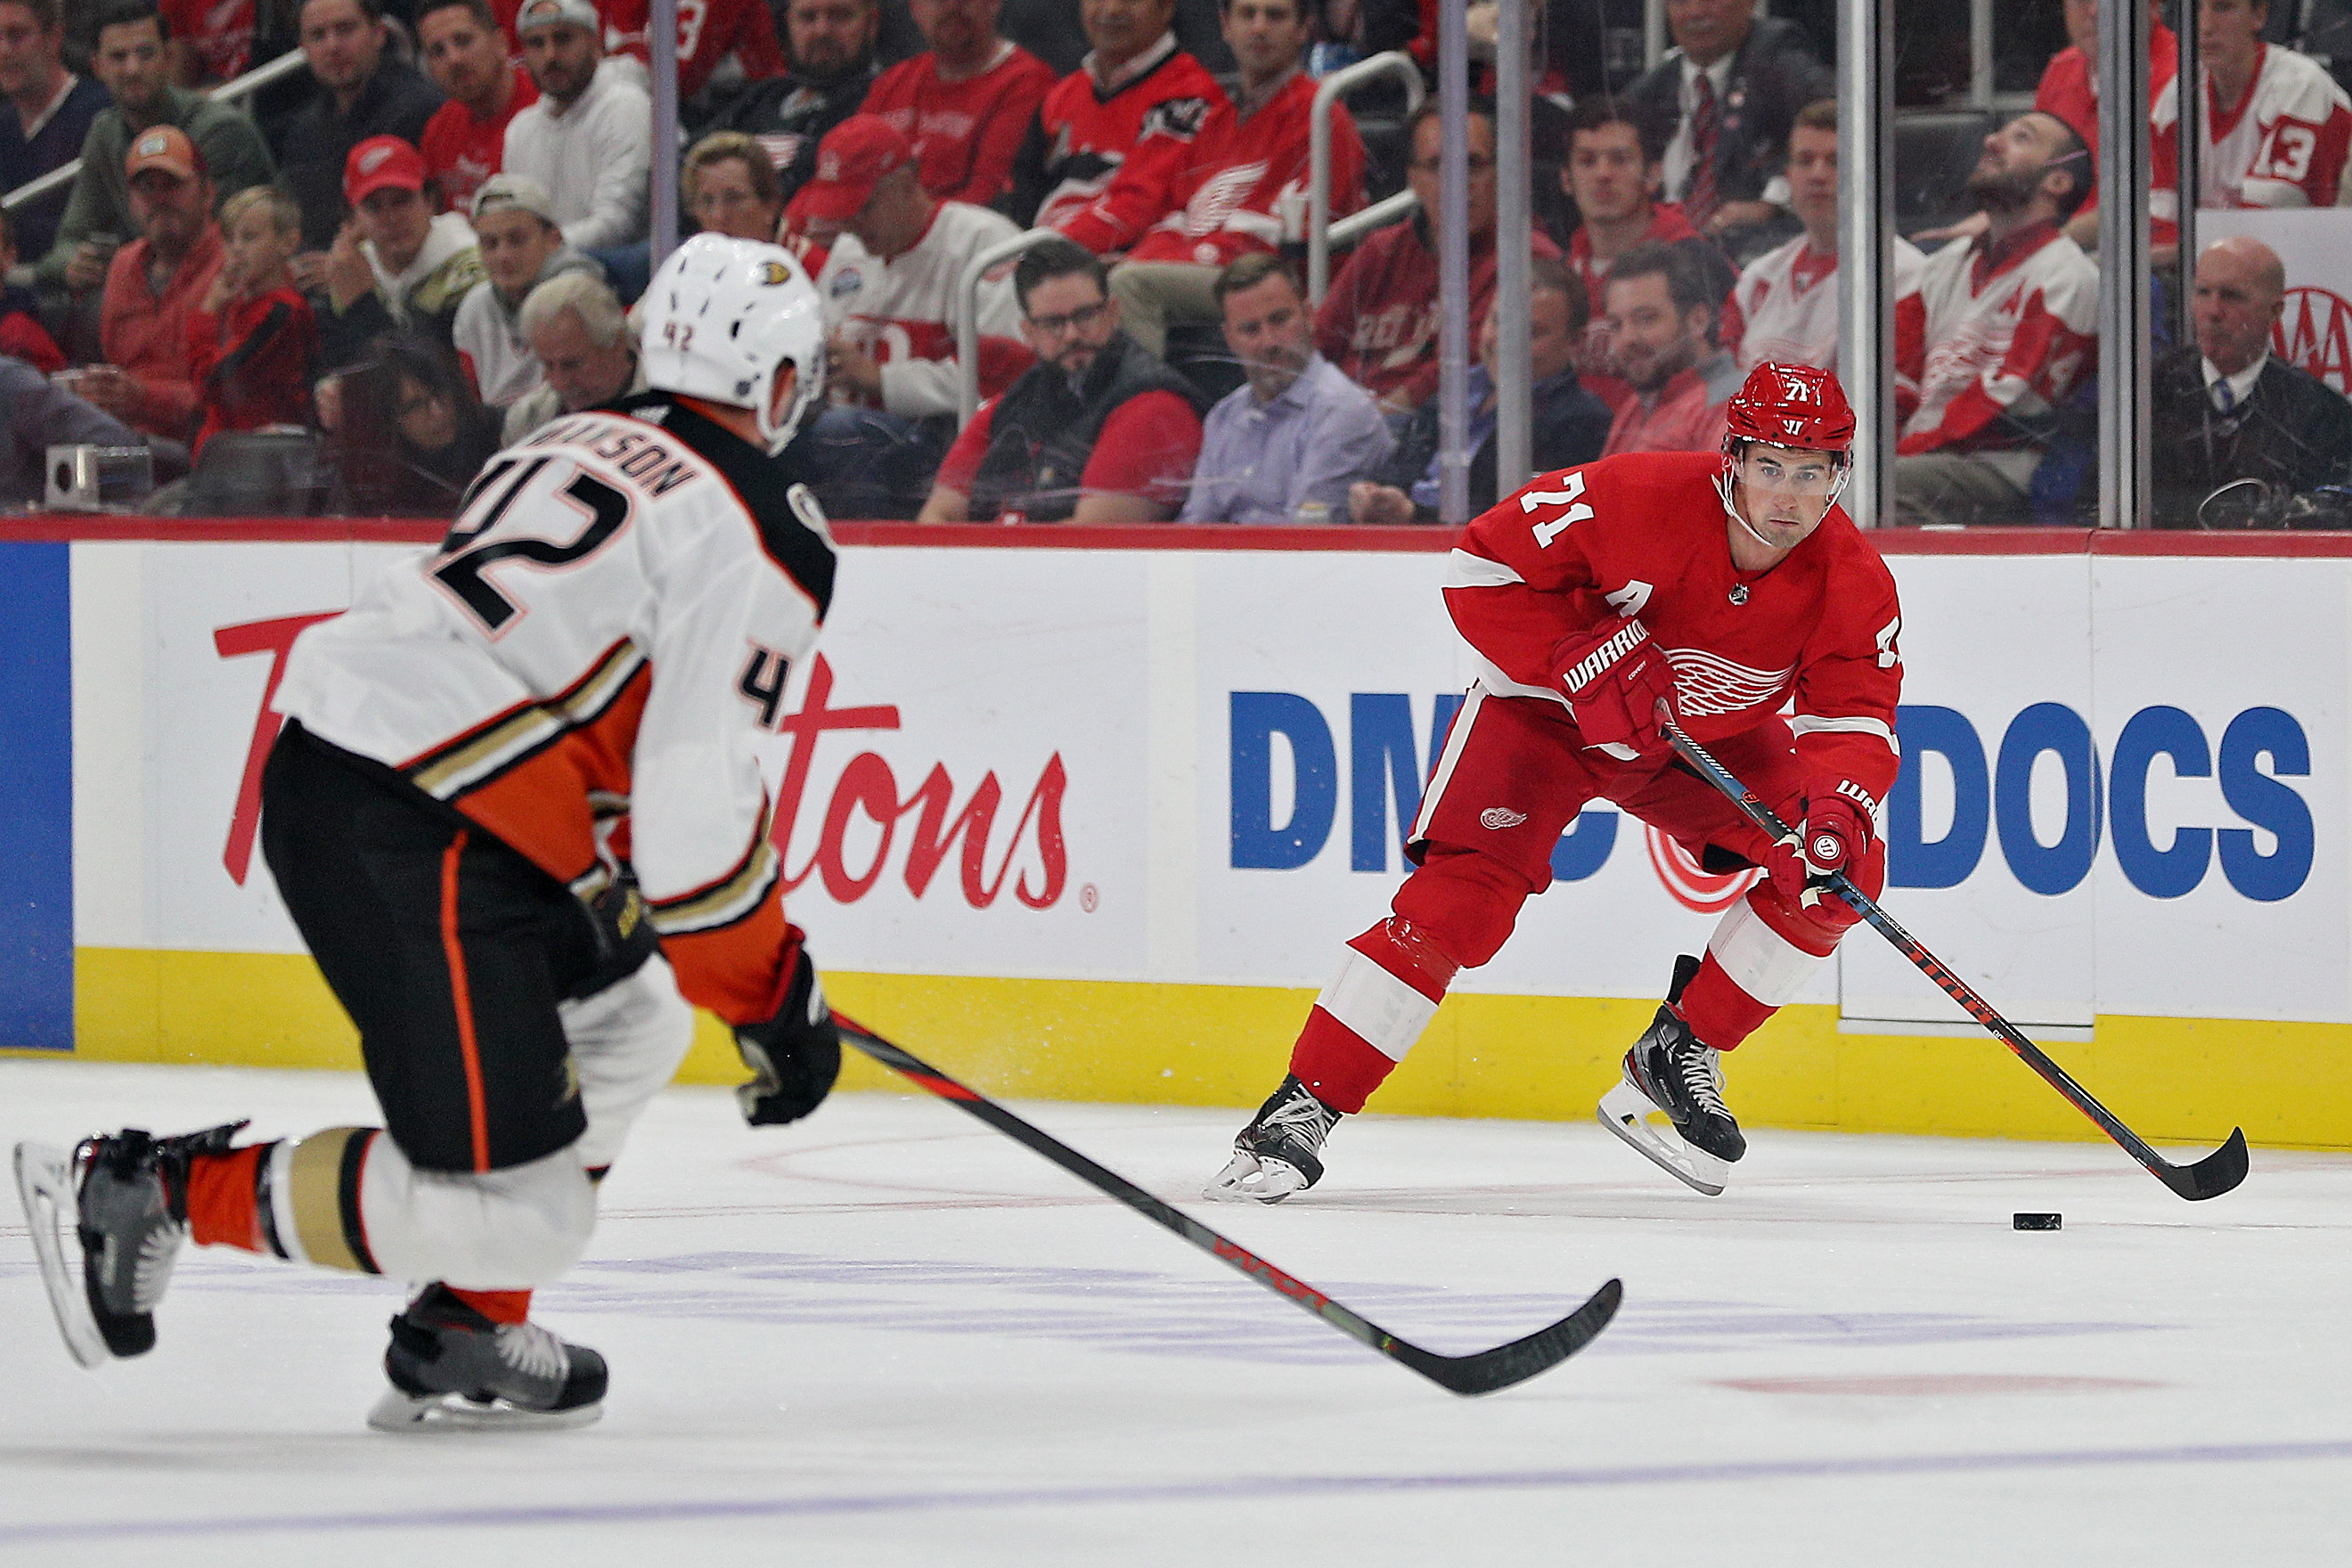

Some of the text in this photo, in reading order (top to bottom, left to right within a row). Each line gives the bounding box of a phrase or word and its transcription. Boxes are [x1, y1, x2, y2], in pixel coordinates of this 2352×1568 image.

[2253, 126, 2316, 182] 13
[663, 321, 694, 353] 42
[1784, 381, 1809, 402] 71
[1520, 471, 1595, 549] 71
[1562, 618, 1651, 694] WARRIO
[1887, 702, 2315, 902] DOCS
